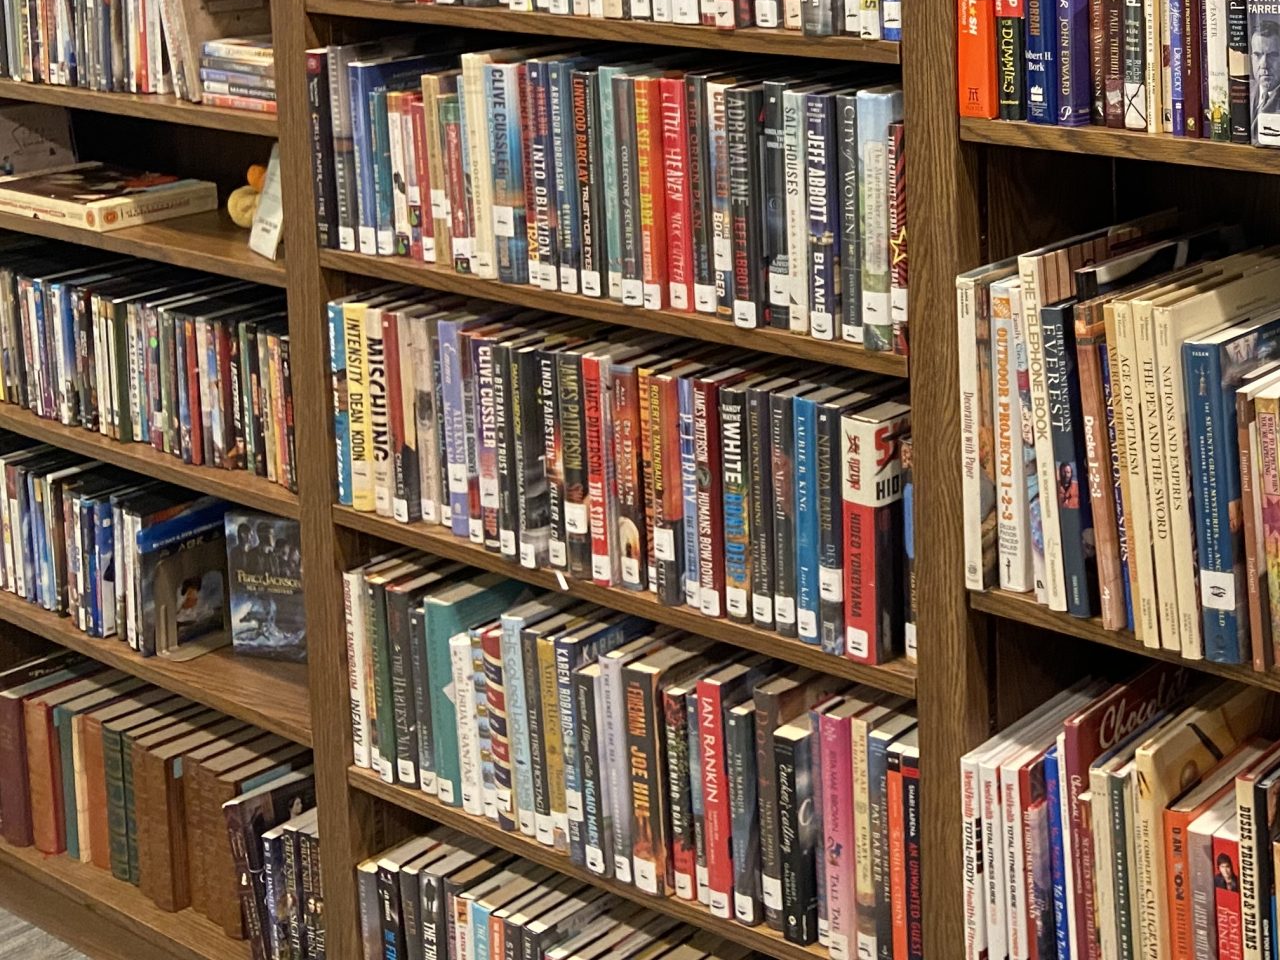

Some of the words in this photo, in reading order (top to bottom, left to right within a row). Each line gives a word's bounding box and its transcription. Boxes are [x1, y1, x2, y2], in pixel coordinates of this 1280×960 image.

[1060, 18, 1068, 45] JOHN
[1002, 28, 1014, 93] DUMMIES
[1061, 48, 1070, 96] EDWARD
[572, 79, 585, 131] LINWOOD
[662, 93, 680, 140] LITTLE
[785, 107, 795, 139] SALT
[533, 144, 544, 180] INTO
[576, 134, 589, 184] BARCLAY
[728, 98, 748, 206] ADRENALINE
[787, 144, 798, 196] HOUSES
[808, 131, 824, 164] JEFF
[664, 148, 683, 200] HEAVEN
[809, 168, 826, 223] ABBOTT
[536, 184, 550, 256] OBLIVION
[1023, 271, 1034, 300] THE
[479, 346, 490, 385] CLIVE
[996, 327, 1010, 398] OUTDOOR
[1026, 308, 1044, 390] TELEPHONE
[368, 338, 388, 462] MISCHLING
[541, 360, 551, 398] LINDA
[1043, 325, 1064, 433] EVEREST
[1163, 365, 1176, 421] NATIONS
[481, 389, 494, 449] CUSSLER
[694, 390, 705, 417] JAMES
[1035, 398, 1047, 440] BOOK
[542, 401, 554, 460] FAIRSTEIN
[696, 419, 707, 463] PATTERSON
[724, 424, 742, 484] WHITE
[999, 402, 1013, 476] PROJECTS
[1084, 416, 1096, 458] Decks
[1169, 426, 1177, 455] AND
[1002, 482, 1014, 522] 1-2-3
[1089, 462, 1101, 497] 1-2-3
[1171, 458, 1182, 510] EMPIRES
[699, 492, 710, 531] HUMANS
[726, 494, 743, 538] BONE
[851, 513, 861, 549] HIDEO
[701, 535, 711, 557] BOW
[850, 553, 862, 617] YOKOYAMA
[557, 647, 569, 684] KAREN
[351, 698, 362, 746] INFAMY
[560, 688, 573, 737] ROBARDS
[628, 685, 646, 737] FIREMAN
[702, 697, 714, 728] IAN
[704, 733, 719, 803] RANKIN
[1240, 805, 1250, 844] BUSES,
[1243, 847, 1253, 902] TROLLEYS
